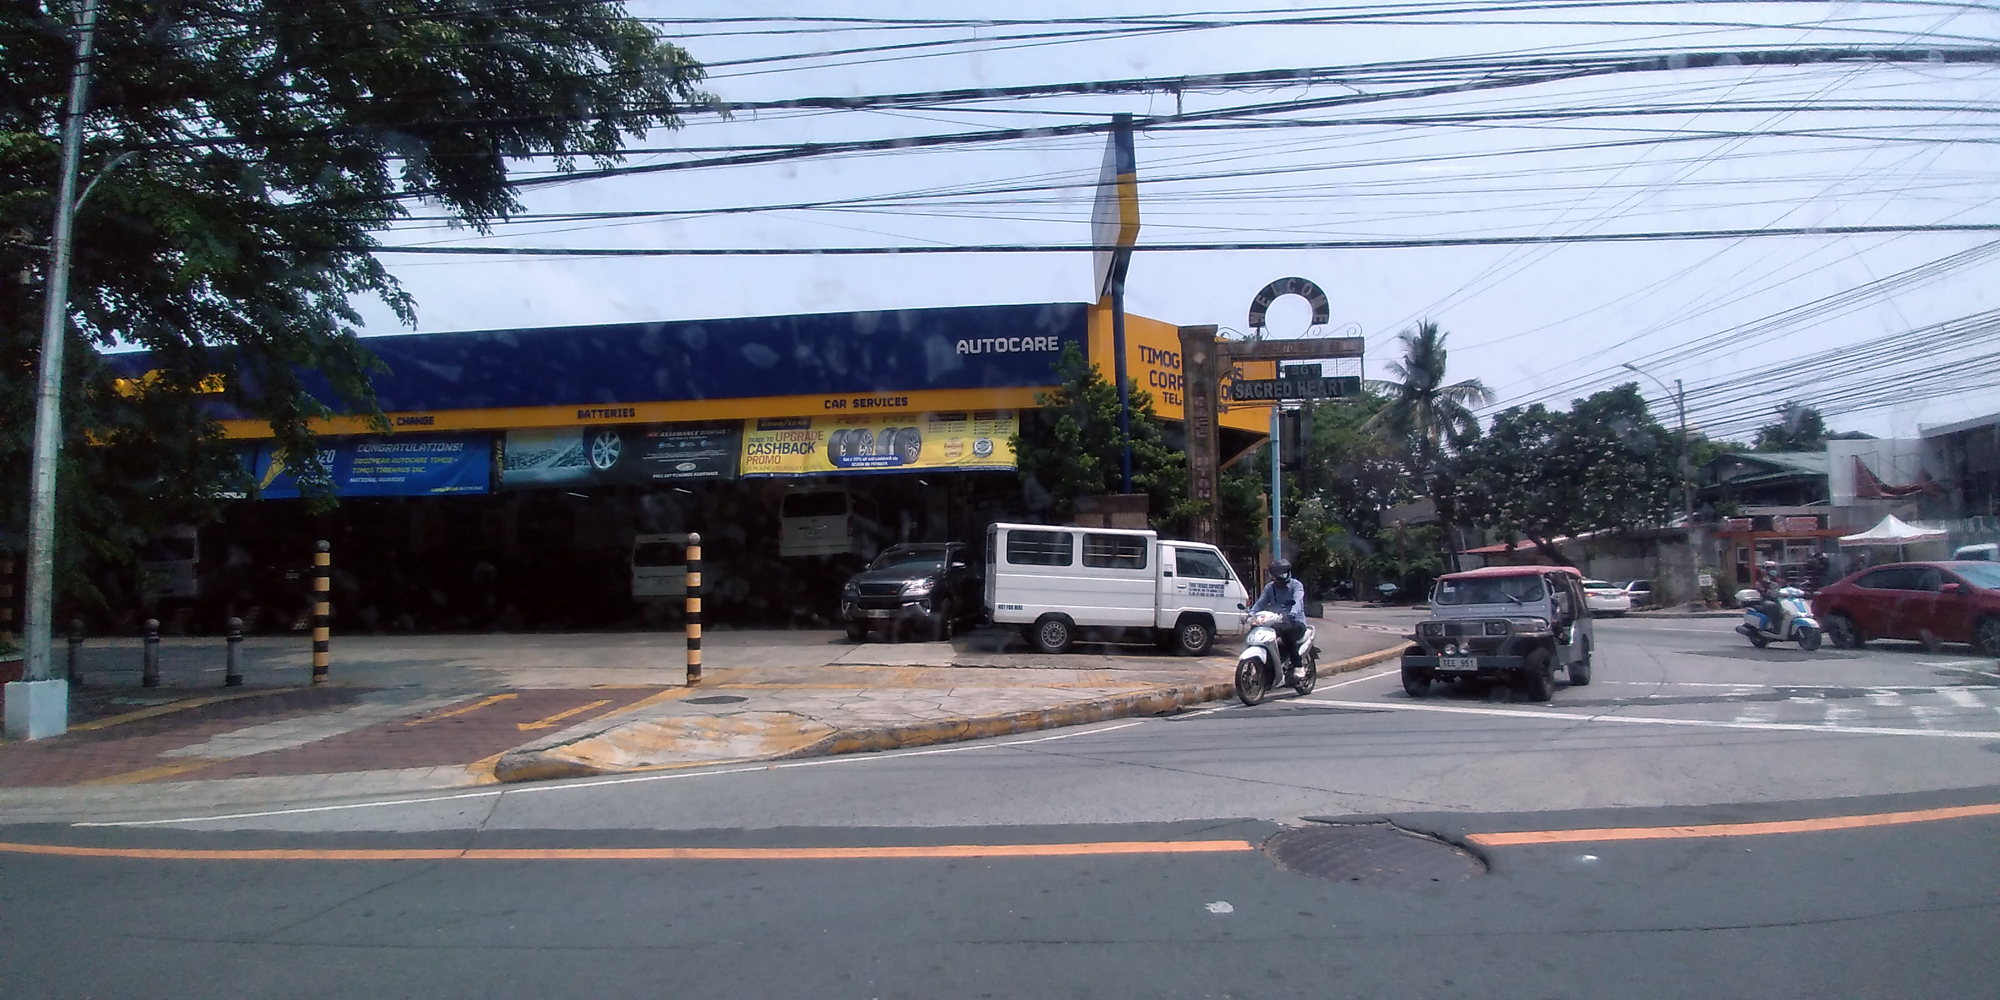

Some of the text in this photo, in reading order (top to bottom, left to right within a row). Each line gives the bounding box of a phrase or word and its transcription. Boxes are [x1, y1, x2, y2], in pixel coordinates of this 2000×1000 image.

[1249, 277, 1328, 325] WELCOME
[956, 335, 1060, 355] AUTOCARE
[1138, 344, 1180, 369] TIMOG
[1291, 365, 1318, 376] BGY
[1235, 380, 1292, 399] SACRED
[1298, 379, 1346, 398] HEART
[824, 396, 908, 409] CAR SERVICES
[577, 408, 636, 419] BATTERIES
[396, 416, 435, 426] CHANGE
[775, 430, 824, 442] UPGRADE
[357, 443, 464, 453] CONGRATULATIONS!
[747, 441, 816, 456] CASHBACK
[391, 456, 427, 464] AUTOCARE
[746, 455, 782, 465] PROMO
